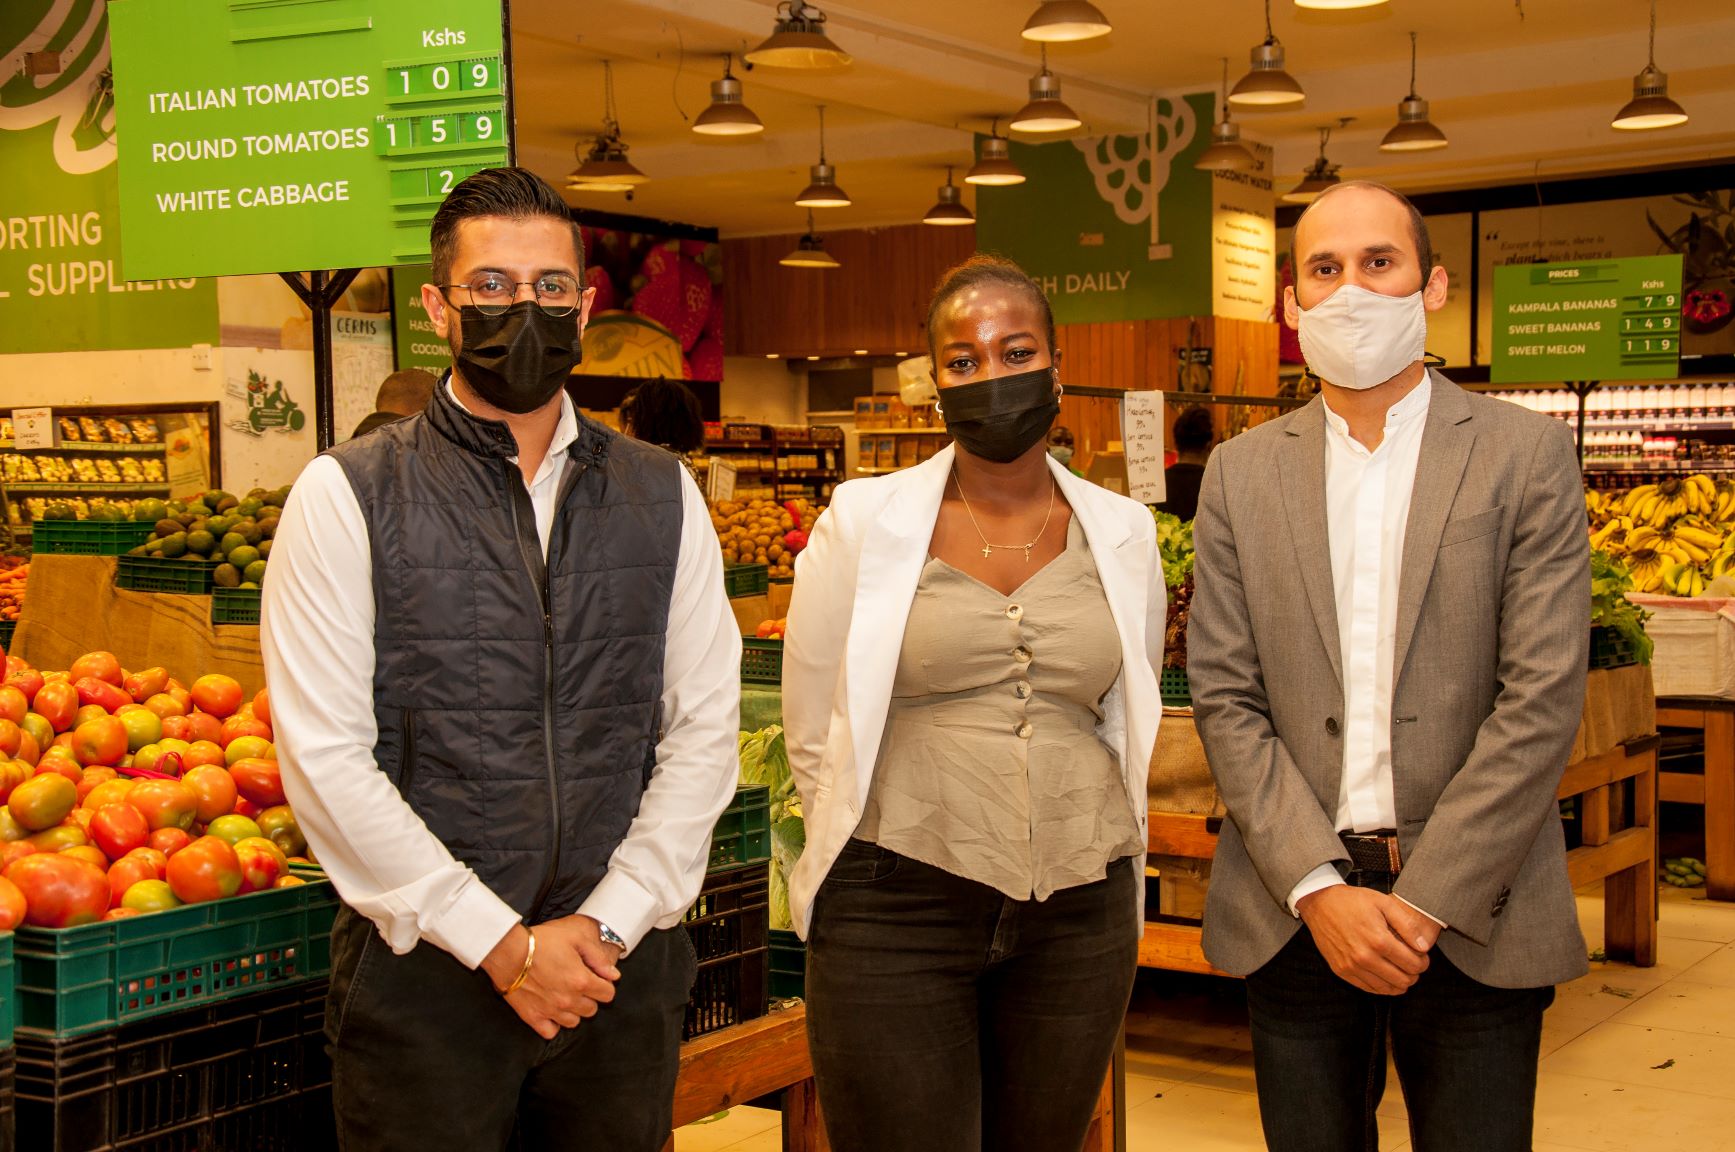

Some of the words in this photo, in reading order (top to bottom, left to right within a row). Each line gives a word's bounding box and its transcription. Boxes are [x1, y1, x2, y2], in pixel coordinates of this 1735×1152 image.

[422, 28, 466, 47] Kshs
[150, 87, 237, 113] ITALIAN
[242, 75, 370, 105] TOMATOES
[152, 138, 237, 162] ROUND
[242, 127, 370, 155] TOMATOES
[156, 189, 232, 213] WHITE
[237, 181, 349, 207] CABBAGE
[28, 259, 197, 297] SUPPL
[1066, 270, 1131, 293] DAILY
[1548, 269, 1580, 279] PRICES
[1642, 280, 1664, 289] Kshs
[1508, 301, 1560, 313] KAMPALA
[1563, 299, 1617, 311] BANANAS
[1508, 323, 1544, 335] SWEET
[1547, 321, 1601, 333] BANANAS
[411, 343, 452, 356] COCONU
[1508, 345, 1544, 356] SWEET
[1547, 344, 1586, 355] MELON
